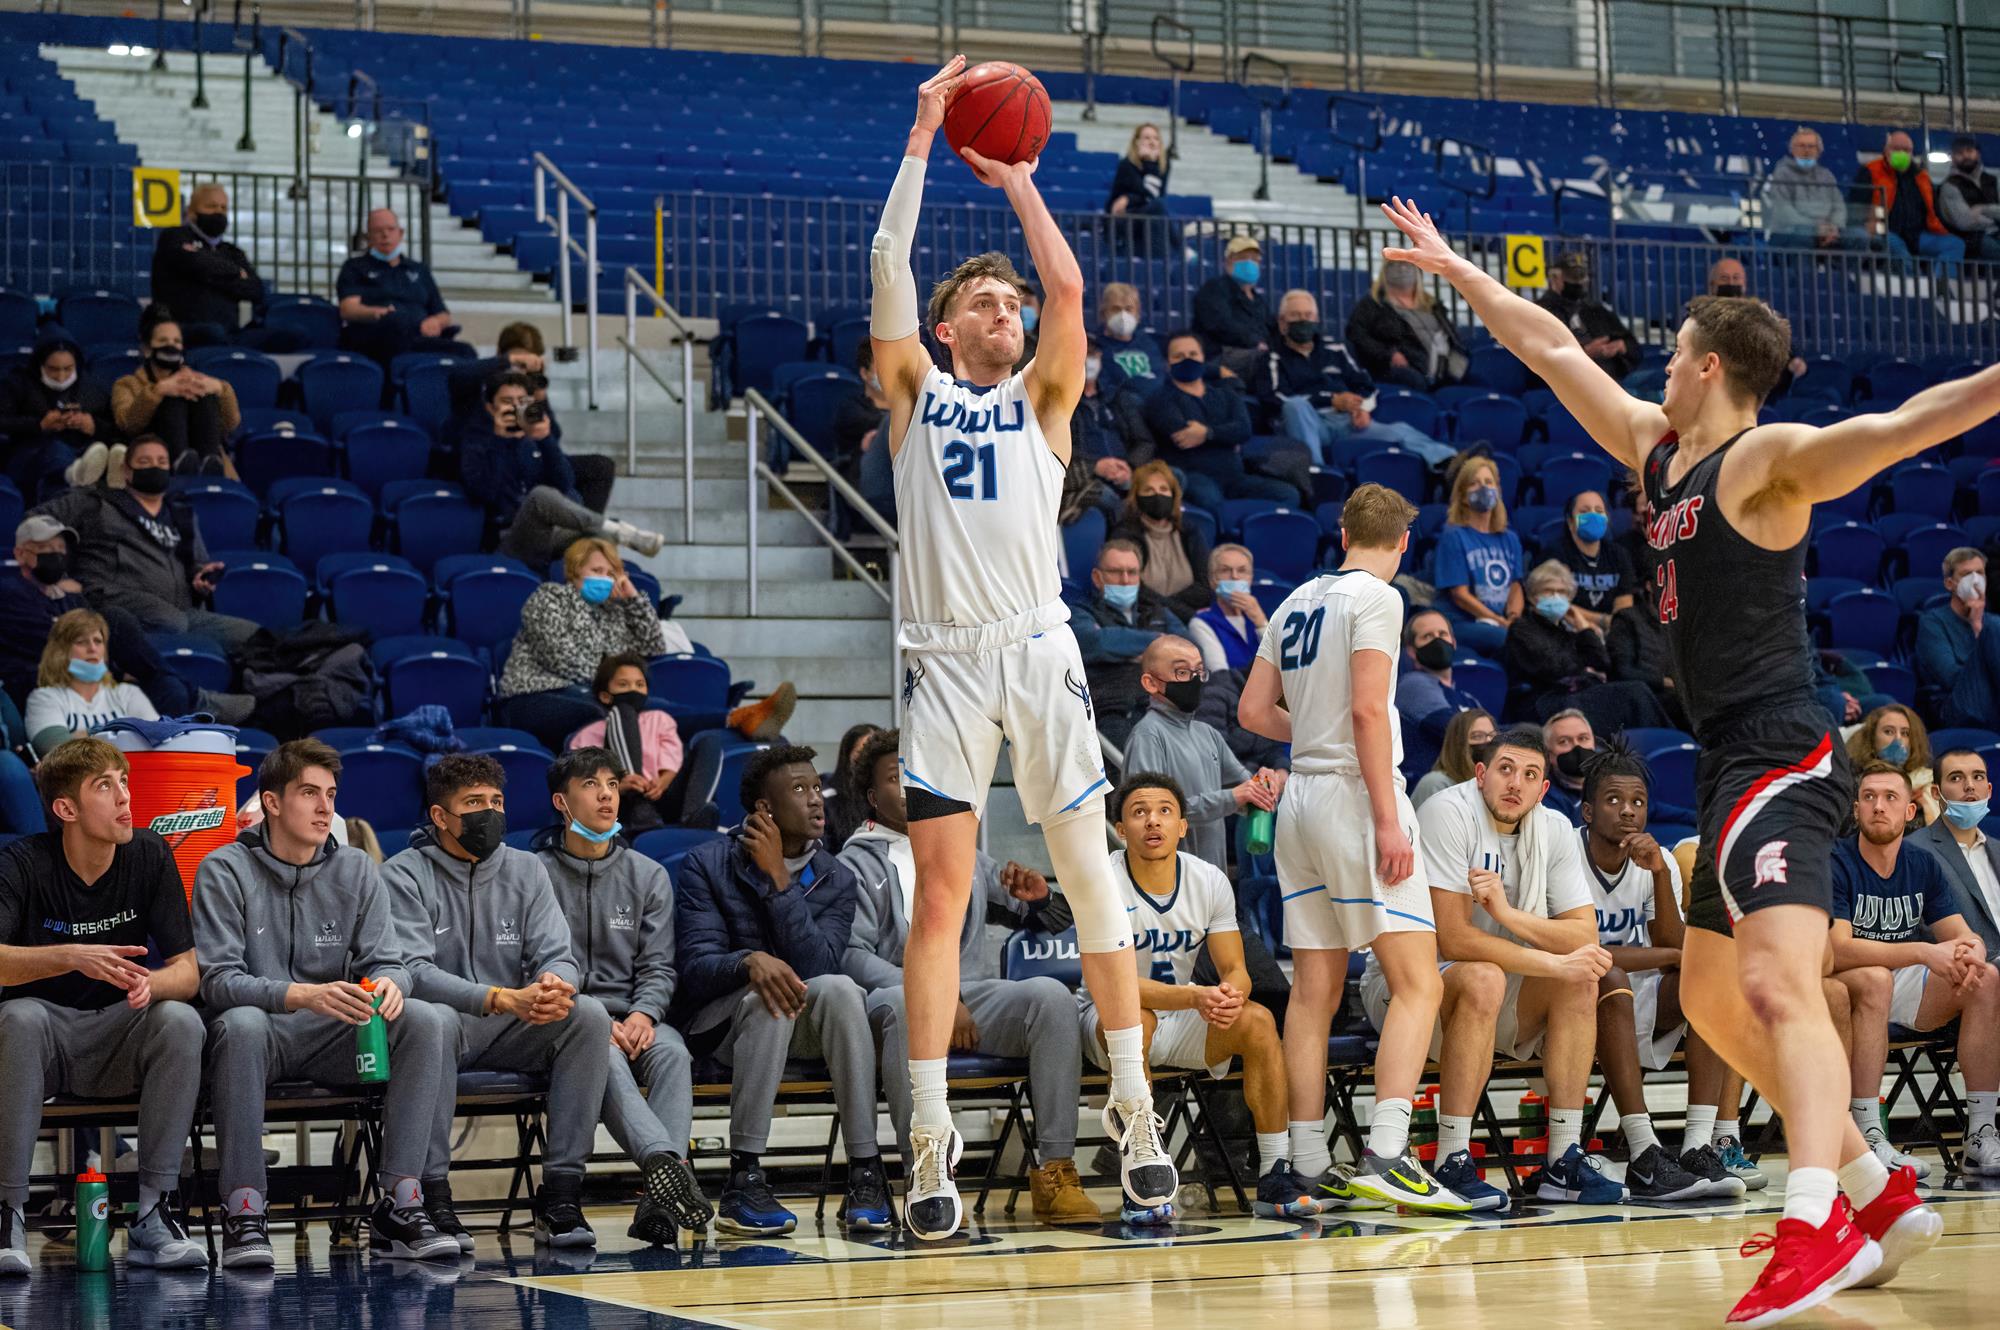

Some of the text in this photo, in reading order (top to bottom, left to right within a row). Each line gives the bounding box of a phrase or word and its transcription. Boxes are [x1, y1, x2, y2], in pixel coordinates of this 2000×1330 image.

[142, 178, 175, 216] D
[1513, 243, 1539, 278] C
[921, 391, 1025, 434] WWU
[942, 440, 998, 501] 21
[1280, 605, 1327, 672] 20
[151, 809, 224, 833] Gatorade
[72, 909, 138, 936] BASKETBLL
[1852, 892, 1924, 931] WWU
[1021, 939, 1081, 960] WW
[356, 1053, 377, 1074] 02
